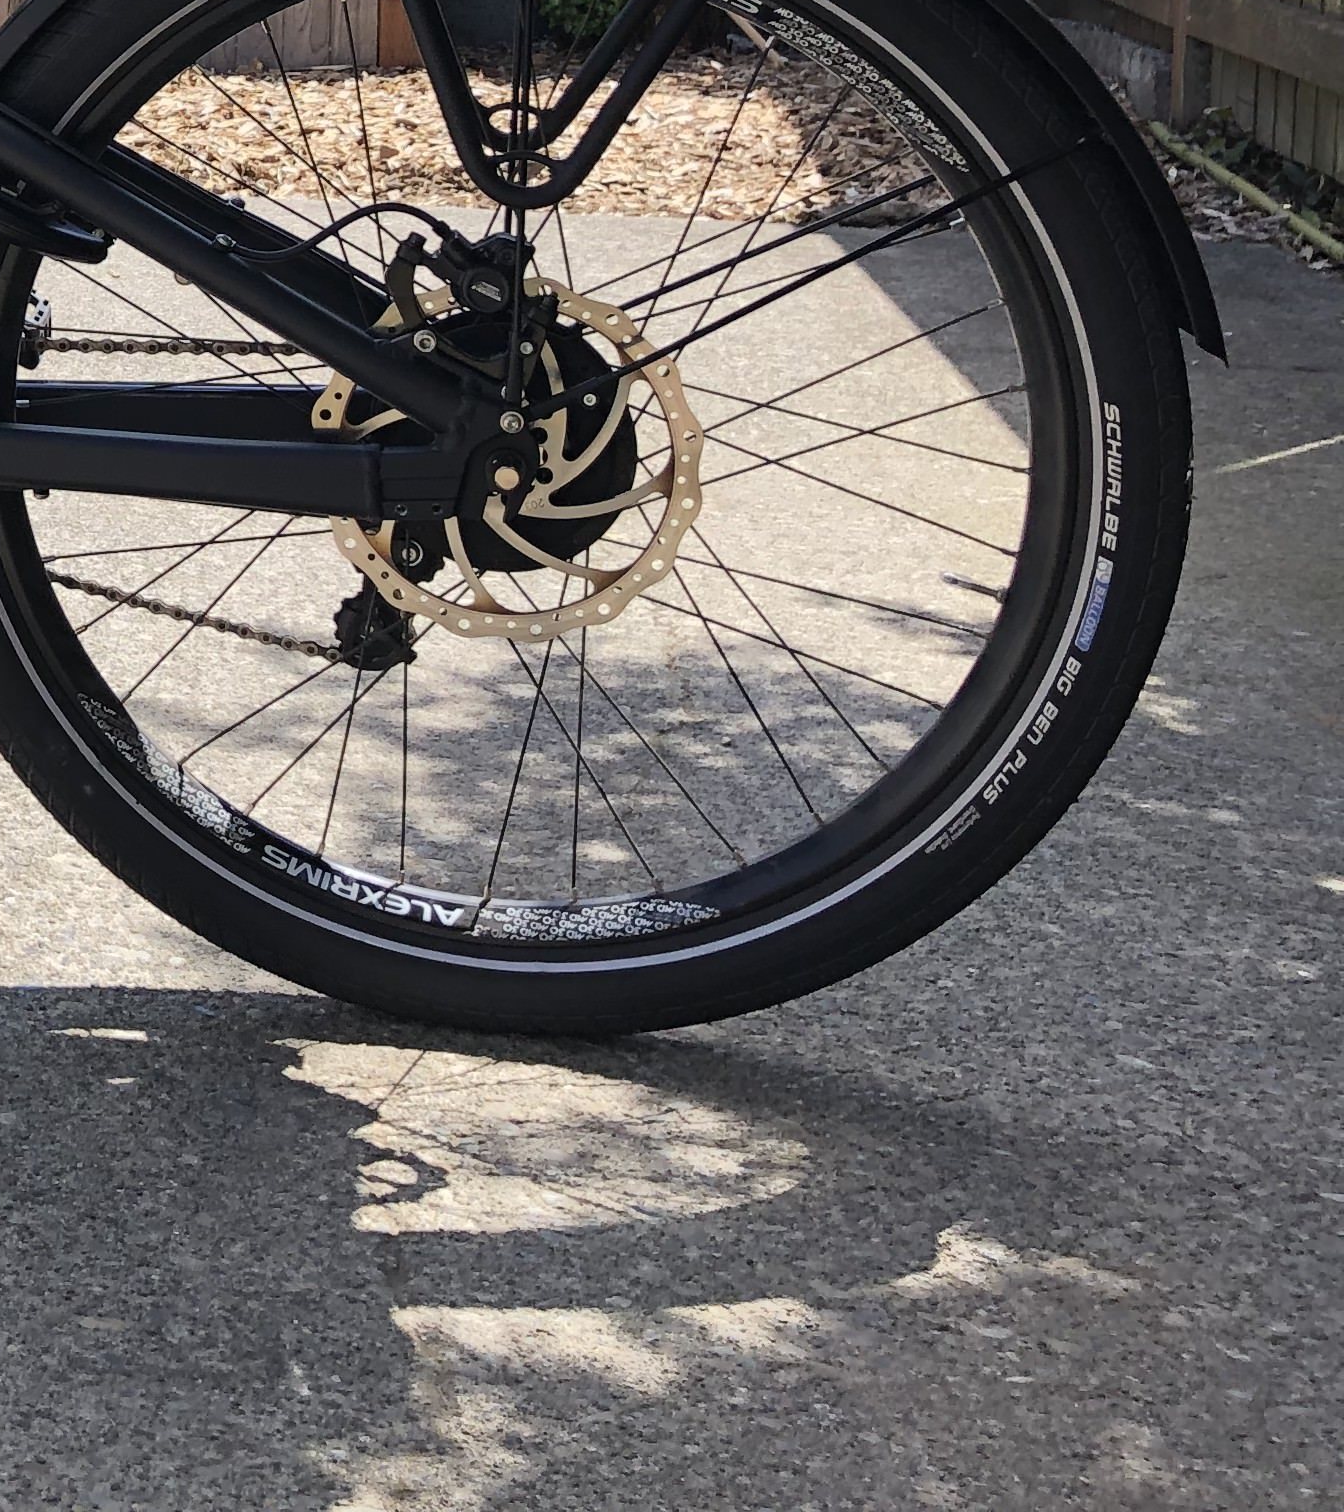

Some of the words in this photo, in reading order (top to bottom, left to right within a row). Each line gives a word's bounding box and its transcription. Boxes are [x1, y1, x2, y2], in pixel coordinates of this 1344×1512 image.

[1102, 401, 1122, 552] SCHWALBE
[1057, 656, 1082, 697] BIG
[1027, 703, 1060, 747] BEN
[982, 748, 1028, 806] PLUS
[262, 844, 464, 926] ALEXRIMS
